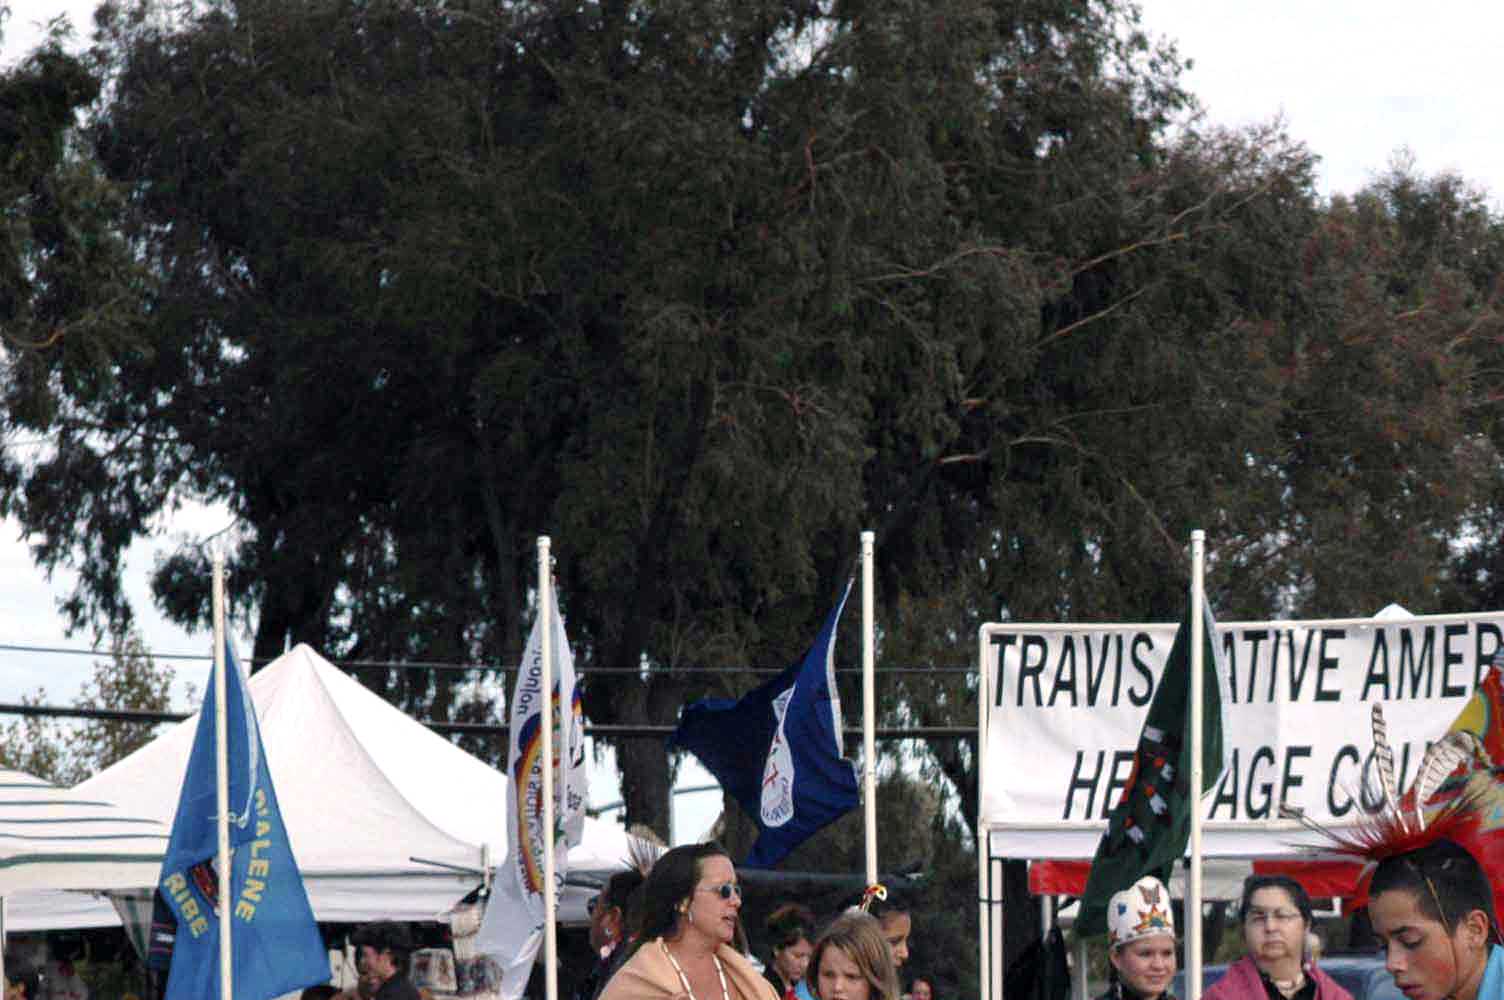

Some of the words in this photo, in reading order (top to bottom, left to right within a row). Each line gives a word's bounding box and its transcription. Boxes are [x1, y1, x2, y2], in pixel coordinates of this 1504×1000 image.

[990, 632, 1154, 707] TRAVIS
[1221, 628, 1346, 703] ATIVE
[1063, 744, 1312, 820] HEAGE
